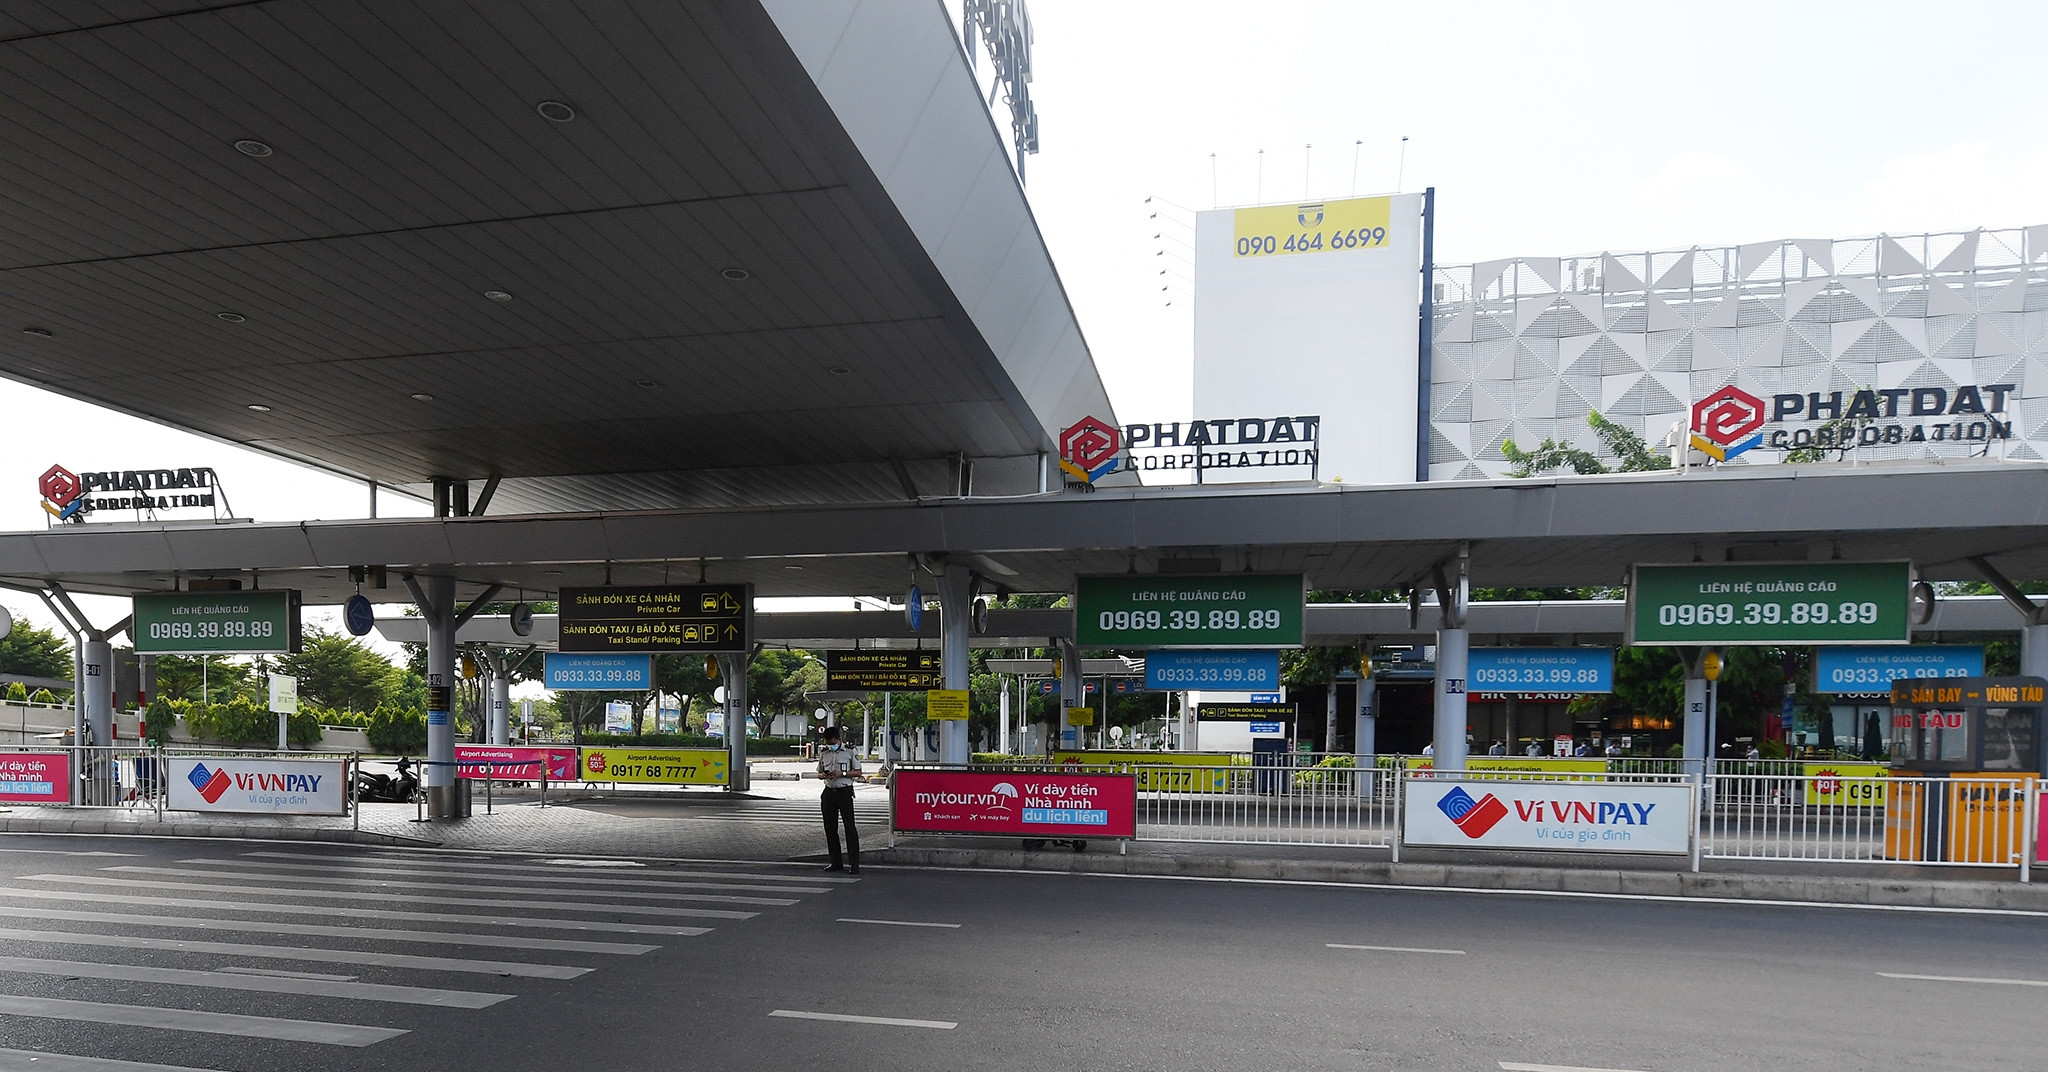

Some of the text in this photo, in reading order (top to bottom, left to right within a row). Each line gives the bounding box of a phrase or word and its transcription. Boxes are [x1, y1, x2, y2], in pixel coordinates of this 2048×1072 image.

[1237, 226, 1386, 256] 090 464 6699
[1773, 384, 2016, 422] PHATDAT
[1125, 416, 1320, 449] PHATDAT
[1771, 421, 2012, 448] CORPORATION
[1125, 450, 1319, 471] CORPORATION
[80, 468, 211, 492] PHATDAT
[84, 494, 214, 510] CORPORATION
[1700, 580, 1836, 595] LIÊN HỆ QUẢNG CÁO
[576, 592, 680, 604] SẢNH ĐÓN XE CÁ NHÂN
[1132, 590, 1246, 602] LIÊN HỆ QUẢNG CÁO
[172, 606, 190, 614] LIÊN
[204, 605, 231, 614] QUẢNG
[233, 605, 249, 613] CÁO
[1660, 602, 1878, 626] 0969.39.89.89
[1100, 610, 1280, 631] 0969.39.89.89
[150, 621, 273, 640] 0969.39.89.89
[563, 624, 586, 634] SẢNH
[590, 623, 608, 634] ĐÓN
[610, 625, 630, 633] TAXI
[637, 624, 651, 633] BÃI
[669, 624, 680, 632] XE
[652, 636, 680, 645] Parking
[554, 669, 641, 682] 0933.33.99.88
[1157, 669, 1266, 682] 0933.33.99.88
[1476, 668, 1598, 683] 0933.33.99.88
[1938, 688, 1962, 703] BAY
[1986, 685, 2018, 702] VŨNG
[2020, 684, 2044, 702] TÀU
[1918, 709, 1963, 729] TÀU
[10, 761, 26, 772] dày
[611, 765, 697, 778] 0917 68 7777
[19, 772, 42, 781] mình
[235, 773, 322, 792] Ví VNPAY
[13, 783, 28, 794] lịch
[1025, 784, 1098, 797] Ví dày tiền
[259, 795, 273, 804] của
[275, 796, 286, 806] gia
[916, 792, 996, 807] mytour.vn
[1025, 797, 1091, 808] Nhà mình
[1025, 811, 1042, 821] du
[1046, 811, 1070, 824] lịch
[1514, 800, 1656, 826] Ví VNPAY
[1536, 827, 1631, 842] Ví của gia đình
